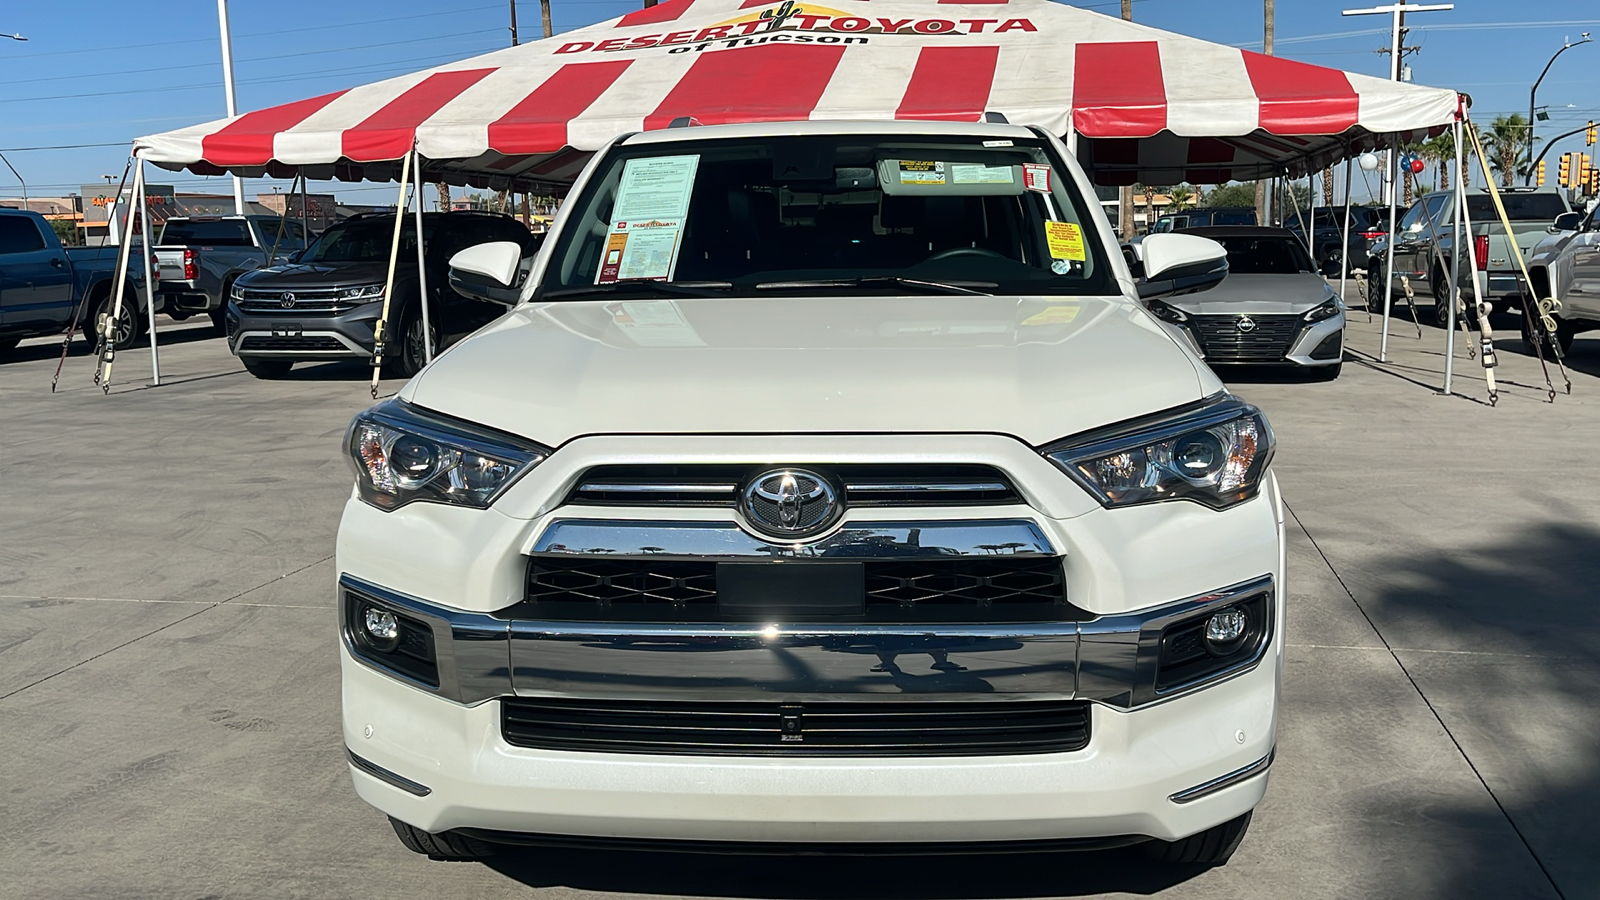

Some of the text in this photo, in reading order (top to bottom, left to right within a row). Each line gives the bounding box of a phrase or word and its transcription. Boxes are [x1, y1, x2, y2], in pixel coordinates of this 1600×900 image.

[552, 14, 1038, 55] DESERT TOYOTA
[668, 34, 869, 54] of Tucson
